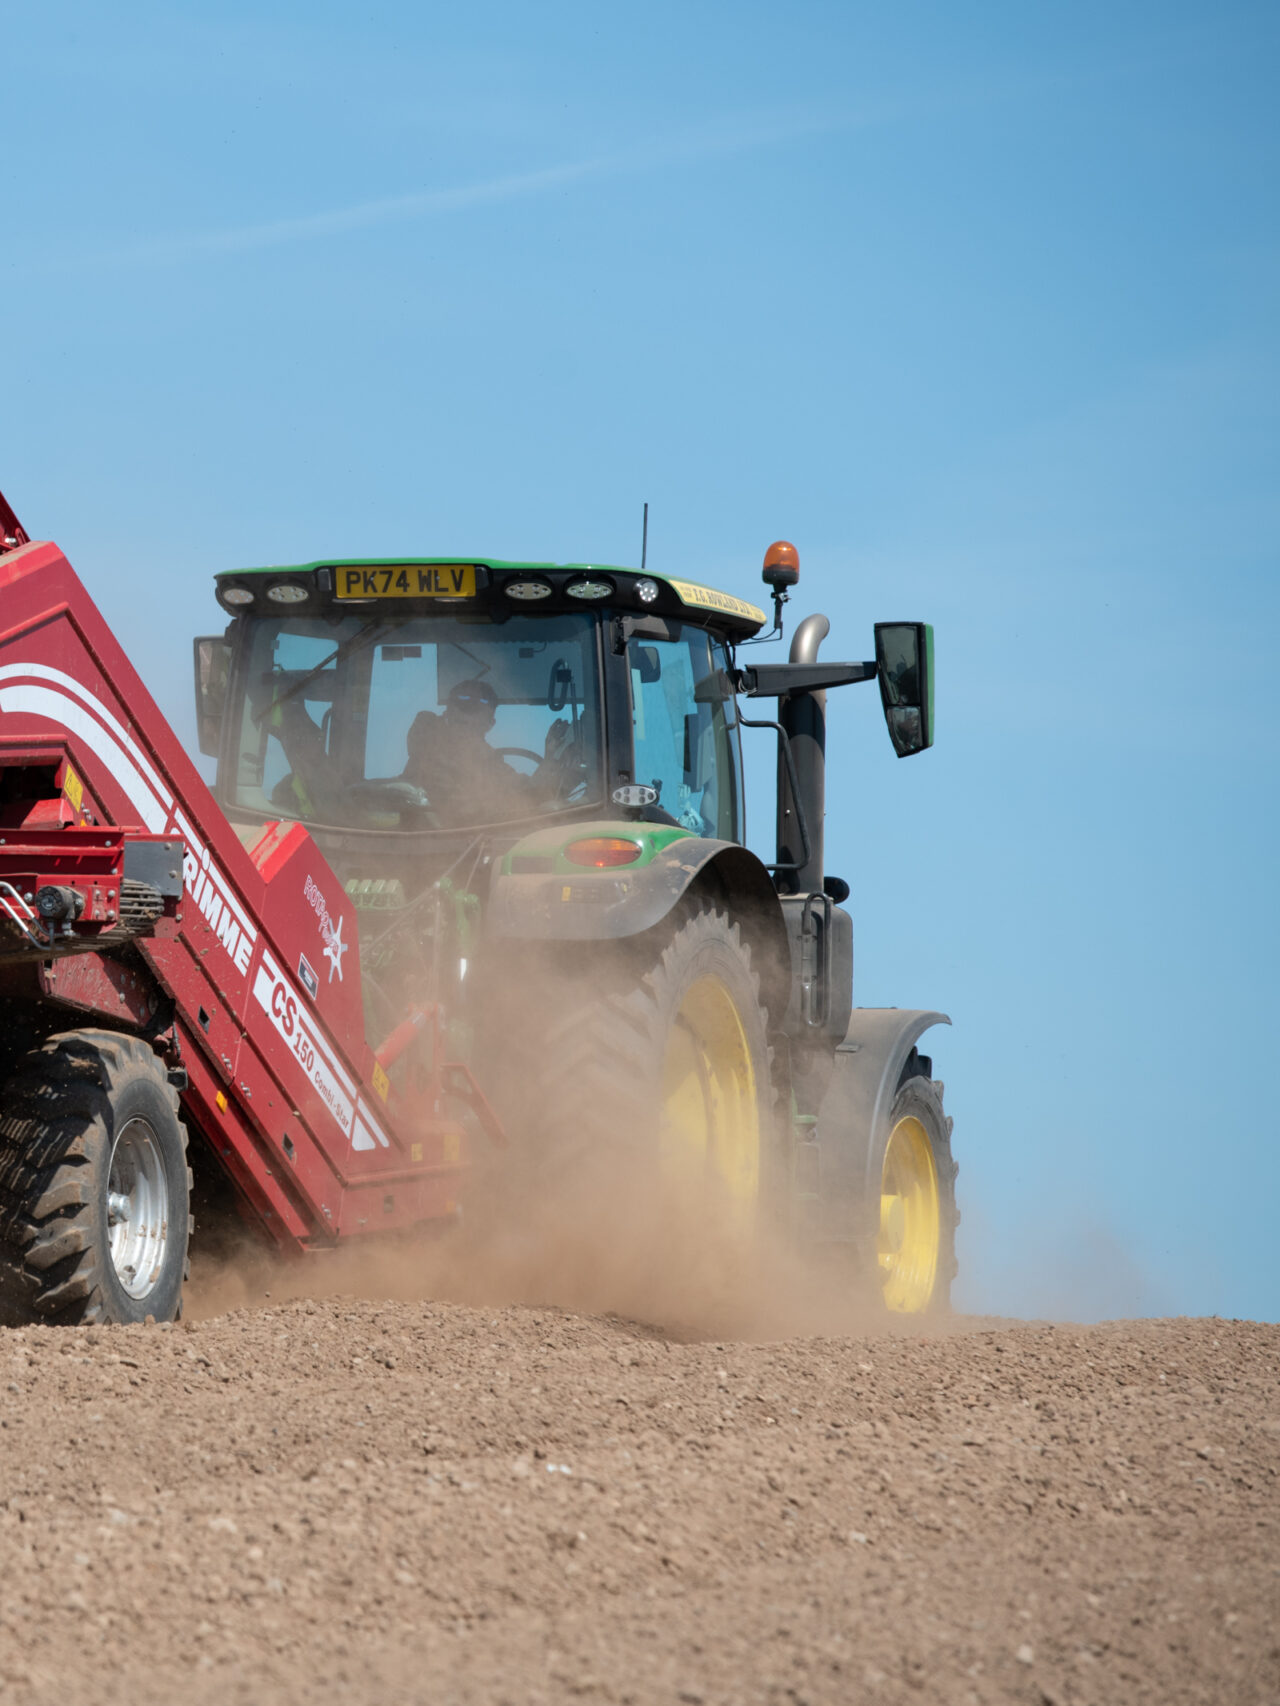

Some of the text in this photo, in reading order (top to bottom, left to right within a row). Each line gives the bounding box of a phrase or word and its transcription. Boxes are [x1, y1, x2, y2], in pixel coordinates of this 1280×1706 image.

[346, 569, 464, 594] PK74 WLV
[172, 829, 254, 978] RIMME
